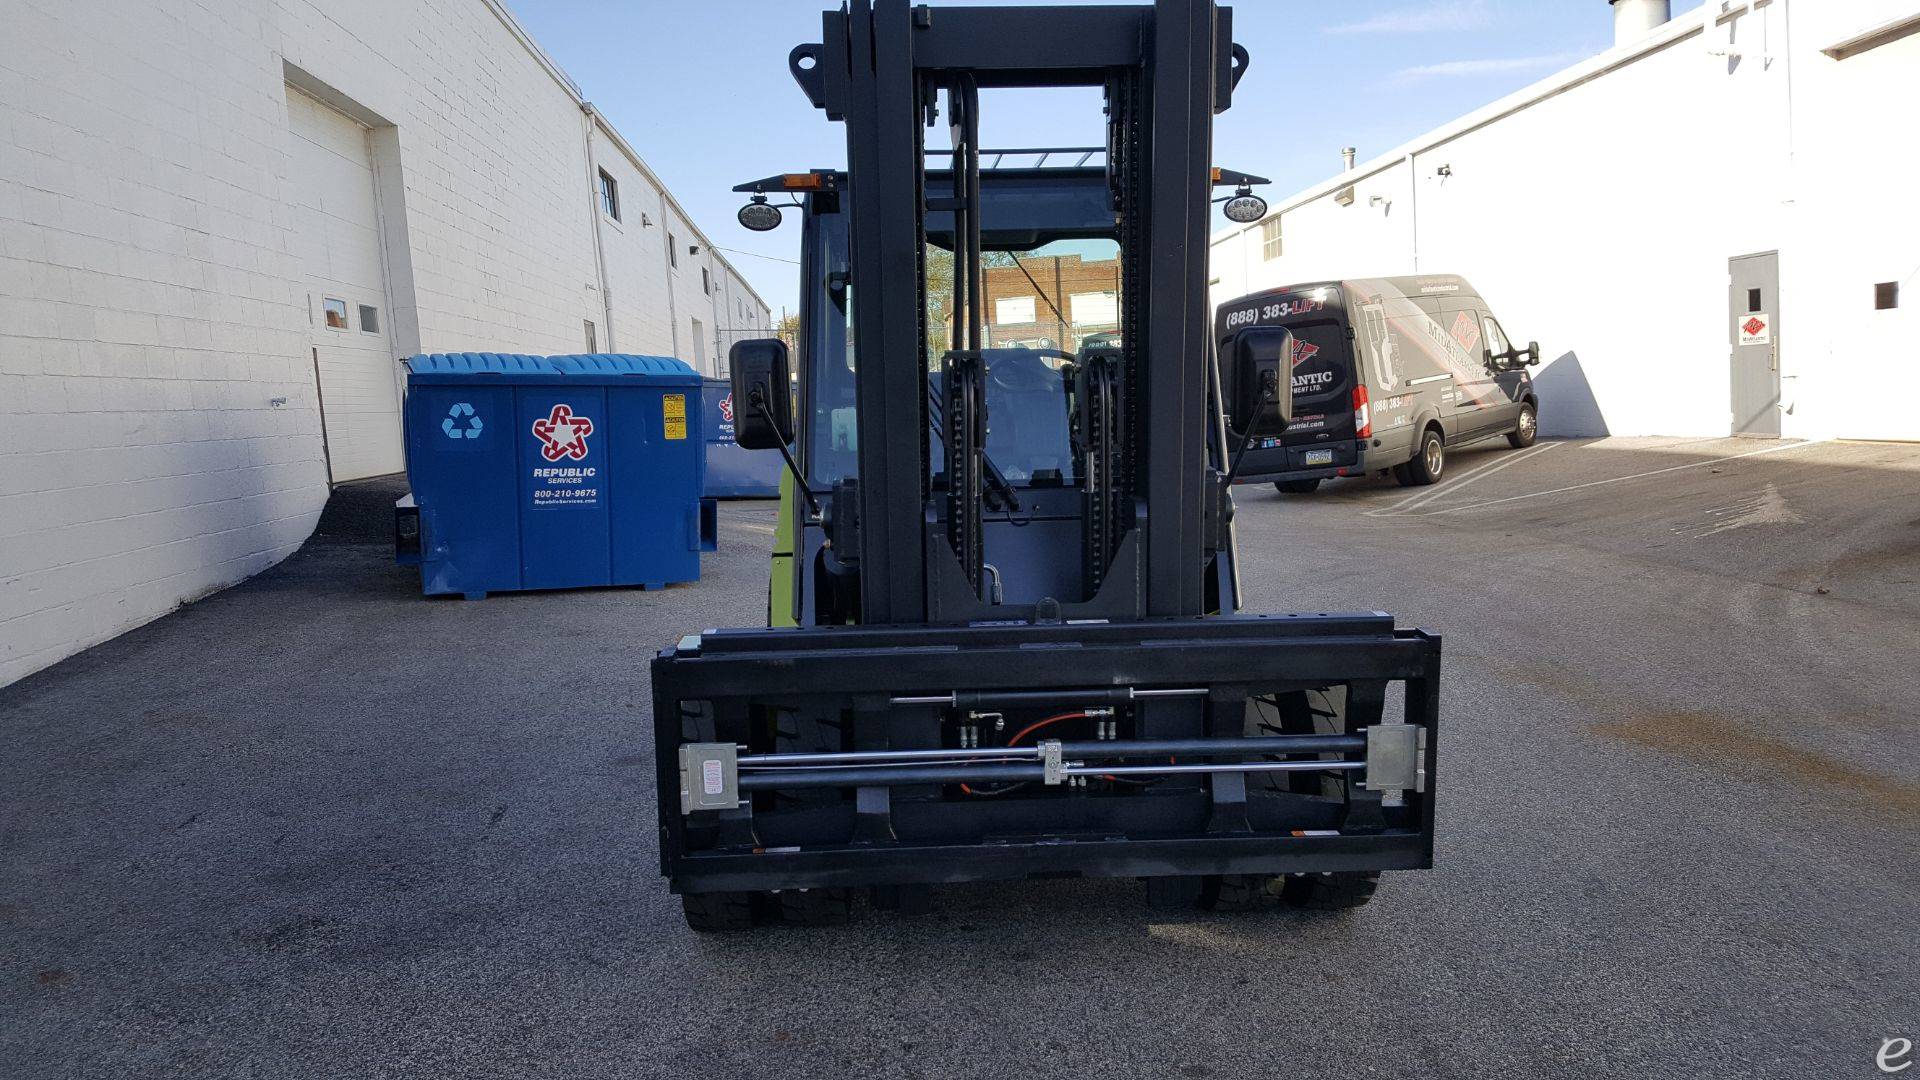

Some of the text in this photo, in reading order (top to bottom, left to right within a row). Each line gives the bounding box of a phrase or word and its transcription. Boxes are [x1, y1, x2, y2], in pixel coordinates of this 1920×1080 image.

[1226, 308, 1259, 330] (888)
[1292, 371, 1332, 387] ANTIC
[1373, 400, 1389, 415] (888)
[533, 467, 596, 478] REPUBLIC
[534, 489, 596, 498] 800-210-9675
